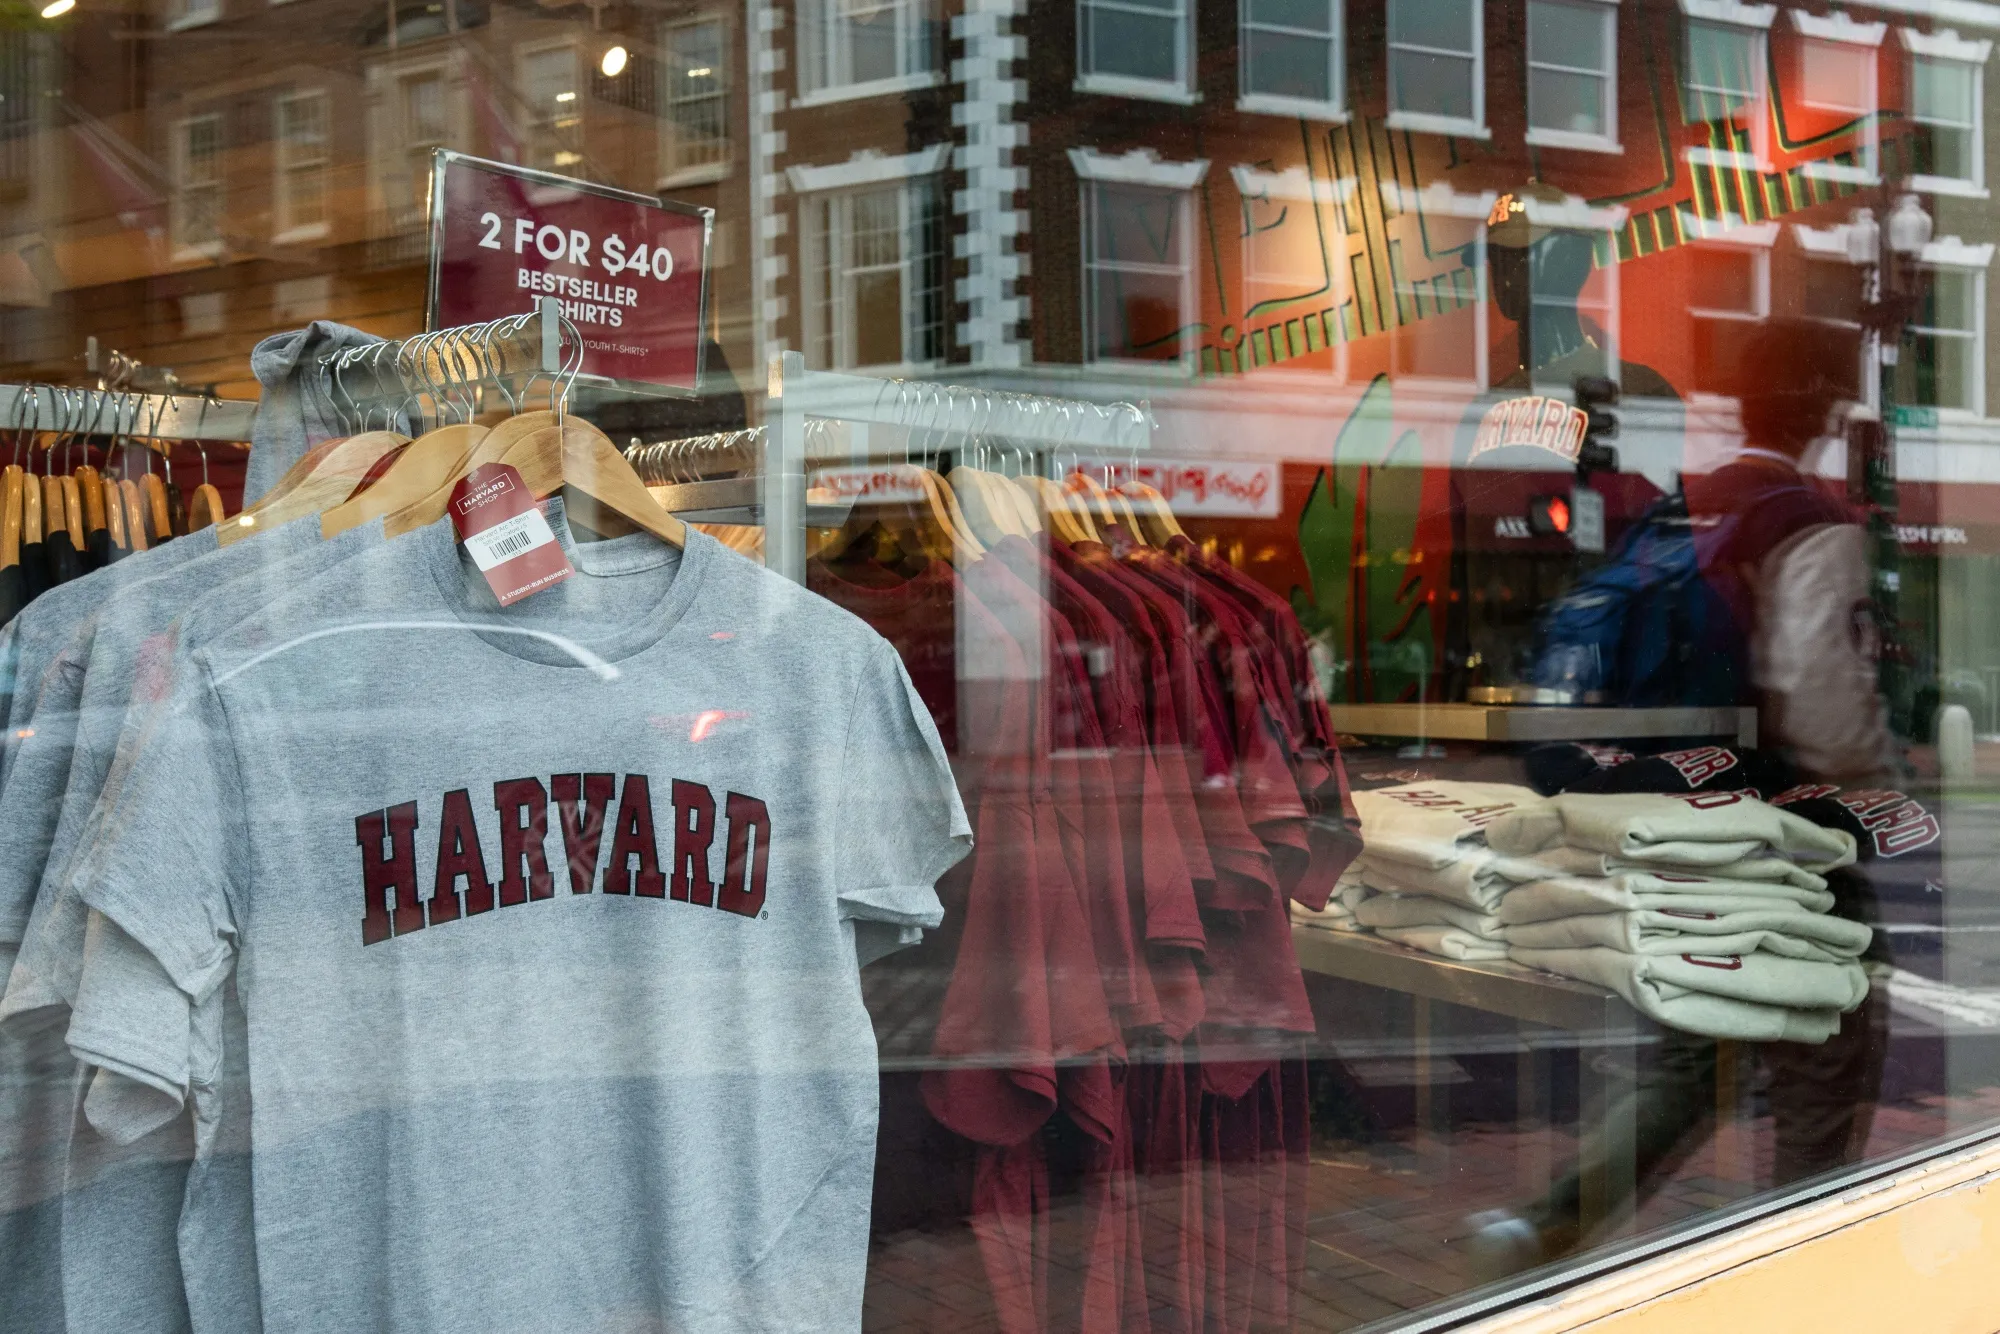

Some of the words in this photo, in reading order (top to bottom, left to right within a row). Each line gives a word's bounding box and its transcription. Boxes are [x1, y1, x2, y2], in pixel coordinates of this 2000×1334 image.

[478, 211, 502, 250] 2
[514, 218, 592, 268] FOR
[601, 233, 674, 282] $40
[517, 267, 638, 308] BESTSELLER
[530, 293, 623, 328] TSHIRTS
[584, 339, 611, 351] YOUTH
[463, 481, 506, 508] HARVARD
[474, 481, 489, 493] THE
[477, 493, 499, 508] SHOP
[473, 529, 498, 544] Harvard
[499, 524, 509, 532] Arc
[509, 514, 530, 527] T-Shirt
[506, 579, 544, 599] STUDENT-RUN
[543, 567, 570, 583] BUSINESS
[354, 772, 772, 947] HARVARD
